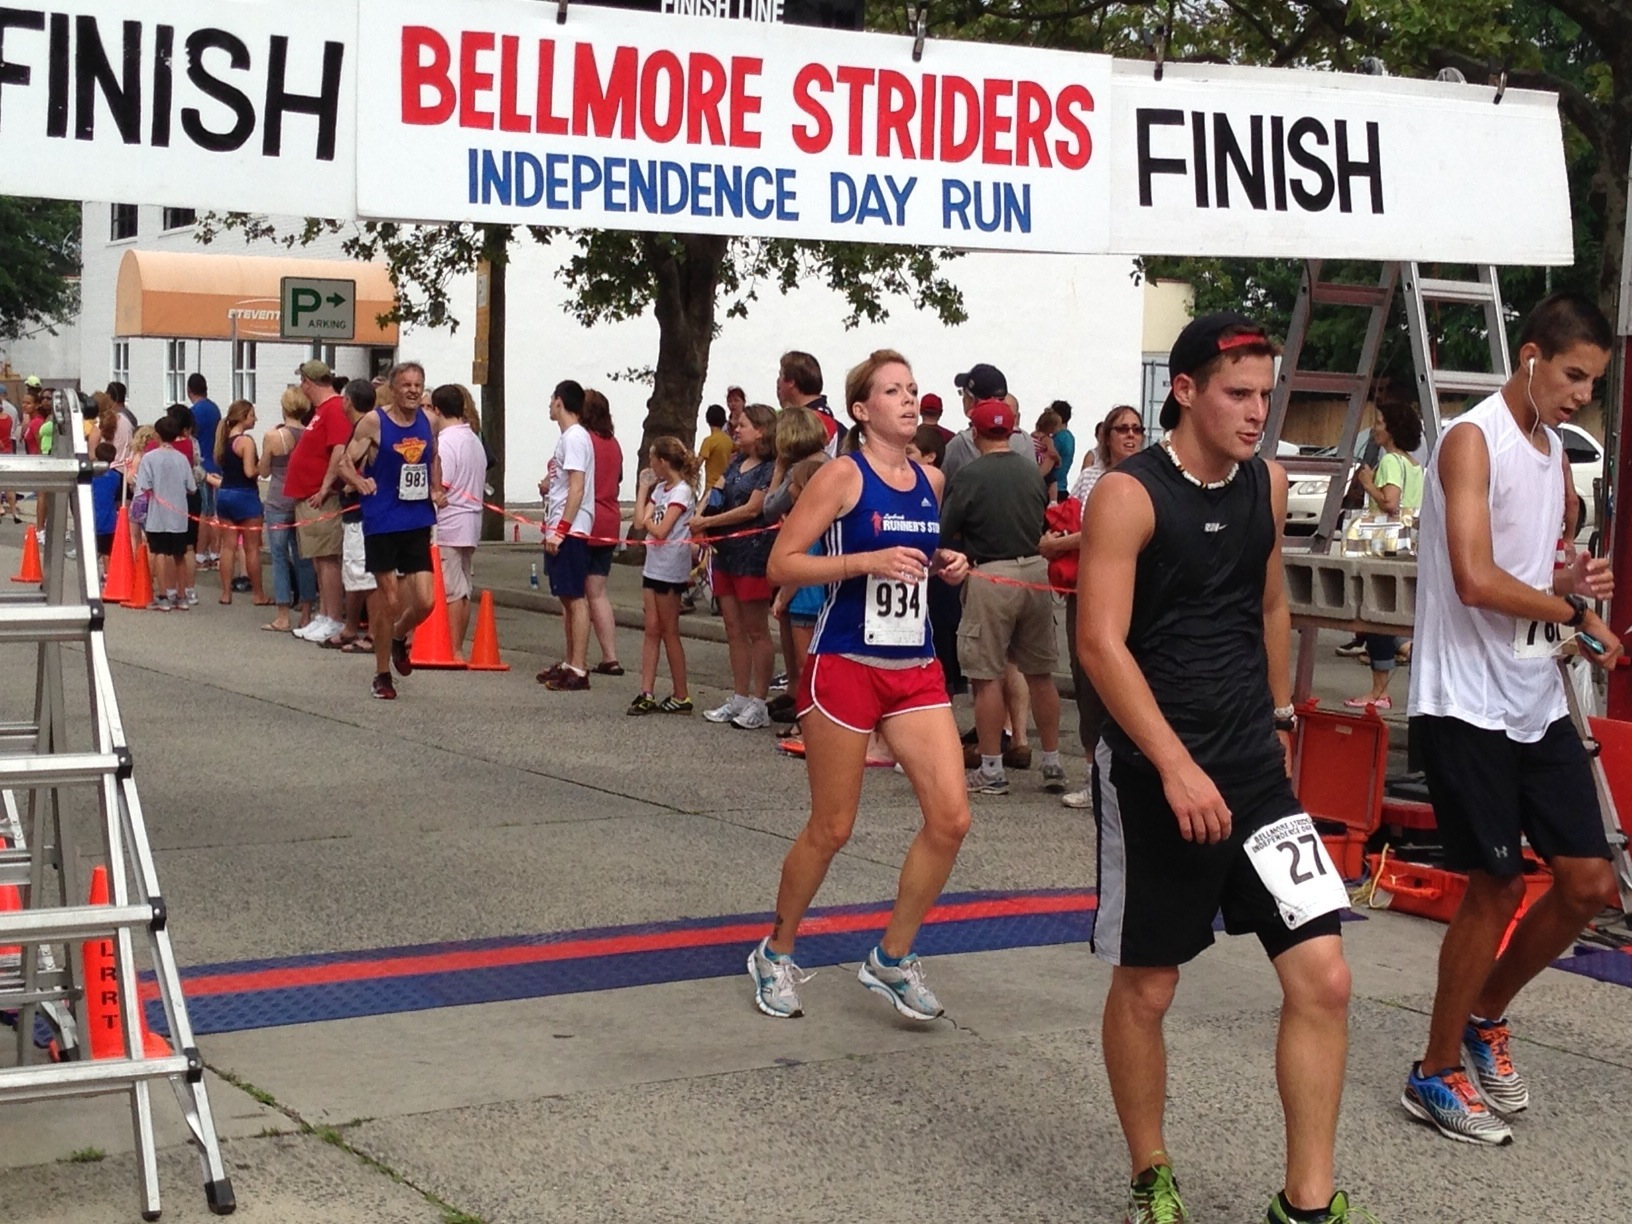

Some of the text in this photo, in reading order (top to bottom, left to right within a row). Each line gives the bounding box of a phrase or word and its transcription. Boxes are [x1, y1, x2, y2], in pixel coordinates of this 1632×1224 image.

[738, 0, 785, 24] LINE
[0, 7, 344, 161] FINISH
[401, 25, 1095, 171] BELLMORE STRIDERS
[1136, 108, 1385, 214] FINISH
[468, 148, 1032, 233] INDEPENDENCE DAY RUN
[291, 287, 322, 327] P
[307, 319, 347, 330] ARKING
[404, 471, 426, 488] 983
[882, 519, 926, 533] RUNNER'S
[876, 582, 920, 618] 934
[1251, 827, 1301, 854] INDEPENDENCE
[1253, 822, 1289, 844] BELLMORE
[1275, 833, 1328, 886] 27
[100, 942, 119, 1030] LRRT
